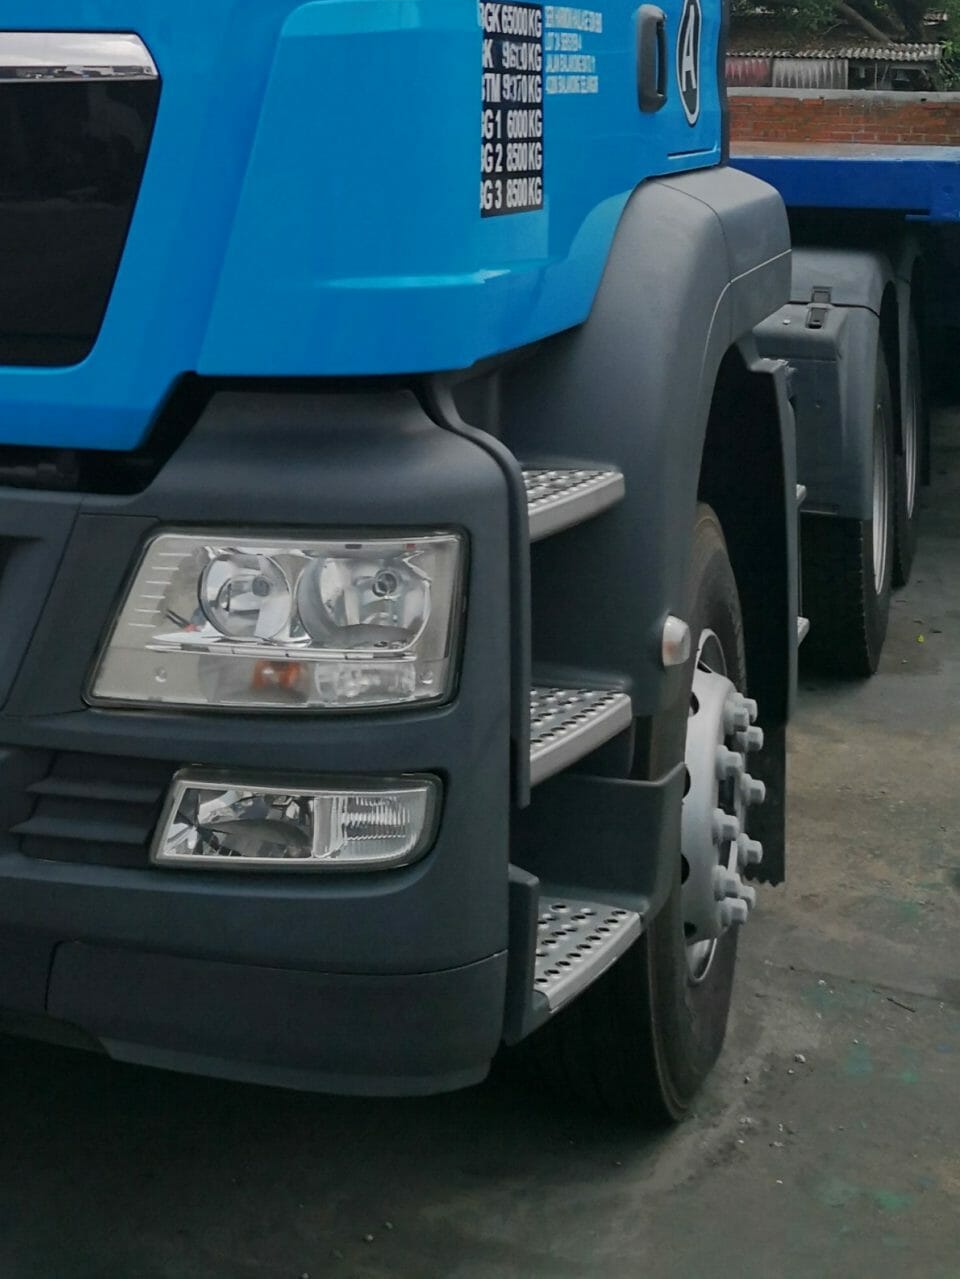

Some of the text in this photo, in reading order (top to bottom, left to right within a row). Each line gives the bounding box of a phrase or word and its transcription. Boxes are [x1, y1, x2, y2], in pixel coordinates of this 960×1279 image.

[495, 109, 502, 138] 1
[495, 143, 503, 172] 2
[494, 179, 502, 209] 3
